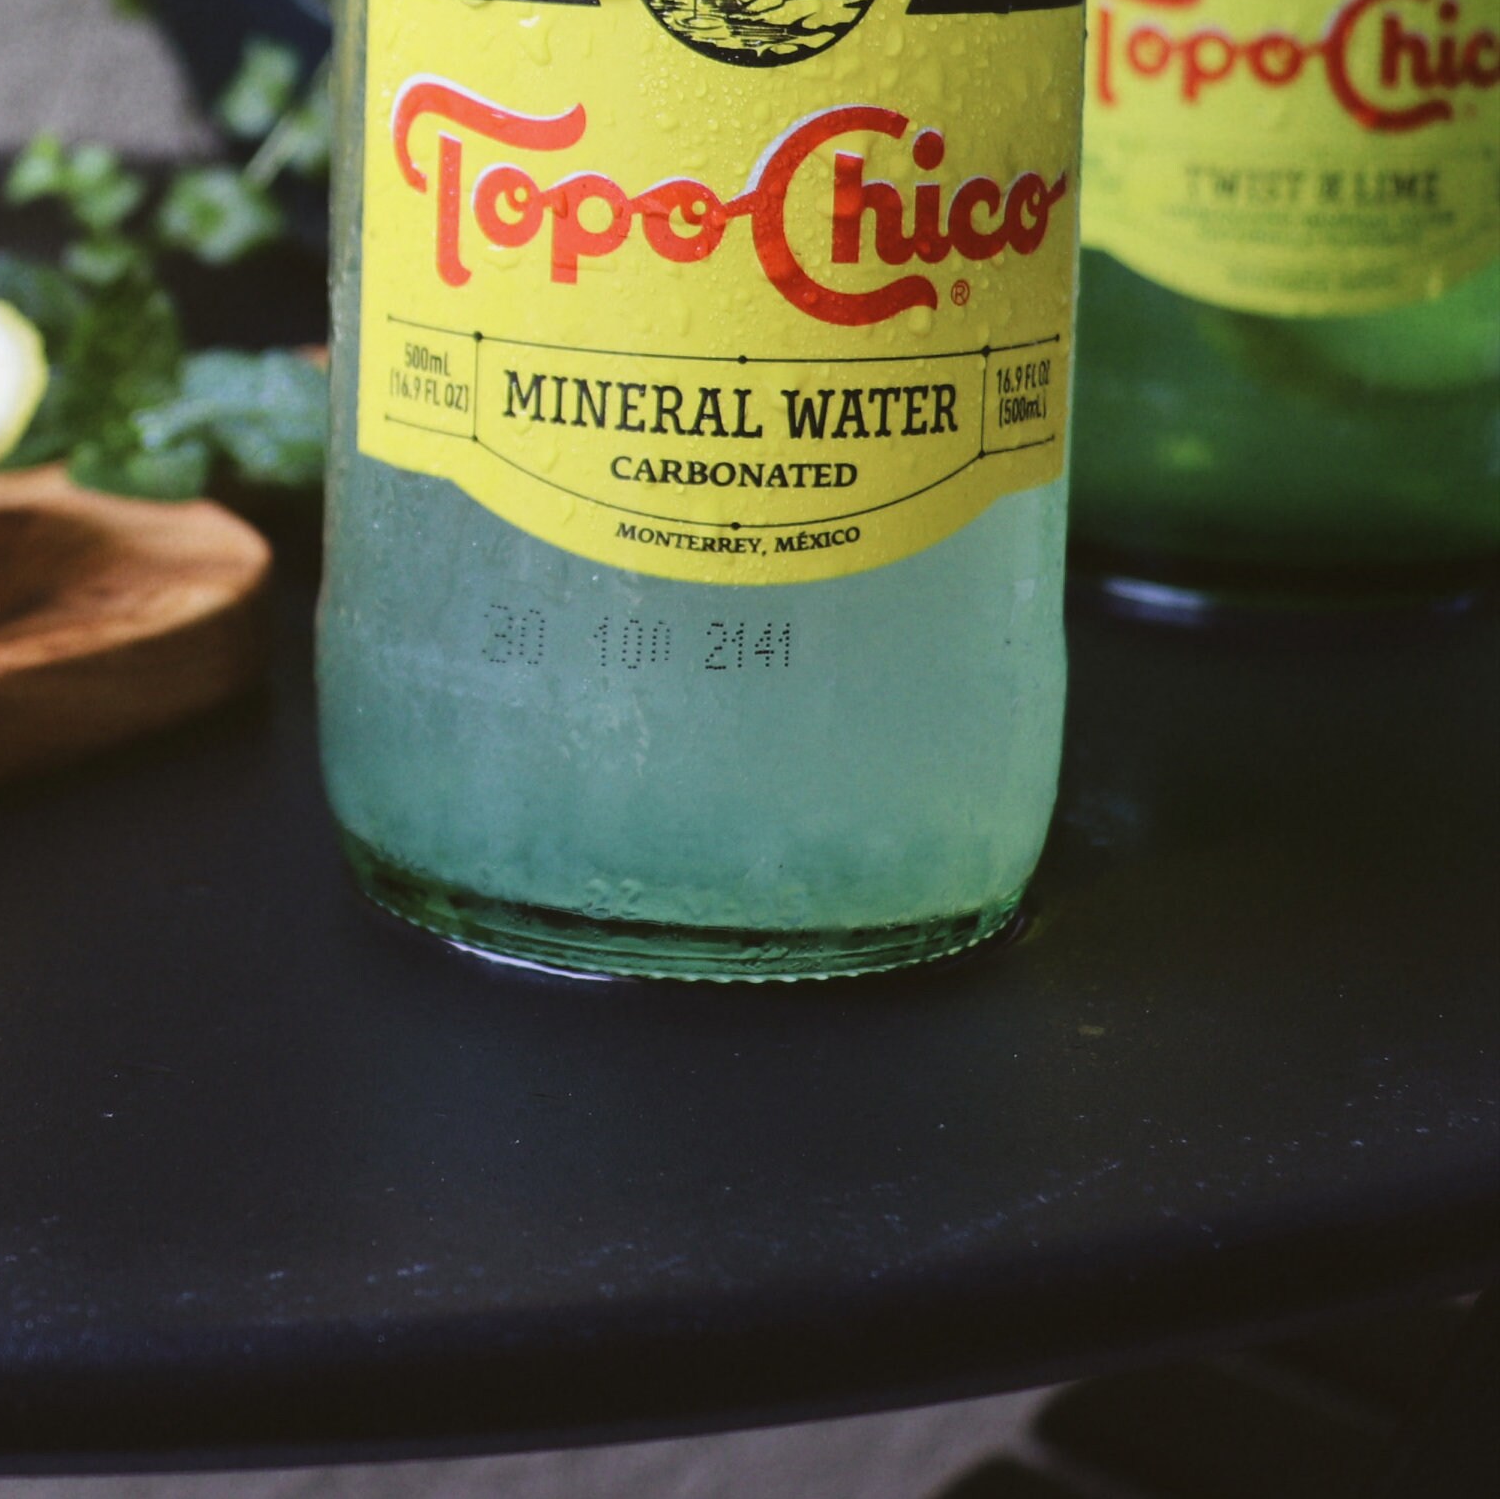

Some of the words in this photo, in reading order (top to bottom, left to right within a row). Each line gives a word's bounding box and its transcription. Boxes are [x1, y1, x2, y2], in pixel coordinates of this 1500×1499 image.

[389, 72, 742, 288] Topo
[743, 102, 1068, 327] Chico
[404, 342, 451, 376] 500mL
[997, 365, 1022, 394] 16.9
[1025, 363, 1037, 390] FL
[390, 367, 421, 400] (16.9
[425, 378, 441, 406] FL
[444, 383, 469, 413] OZ)
[502, 369, 763, 439] MINERAL
[780, 383, 959, 440] WATER
[610, 455, 859, 488] CARBONATED
[615, 522, 768, 556] MONTERREY,
[774, 526, 861, 554] MÉXICO
[704, 621, 791, 670] 2141
